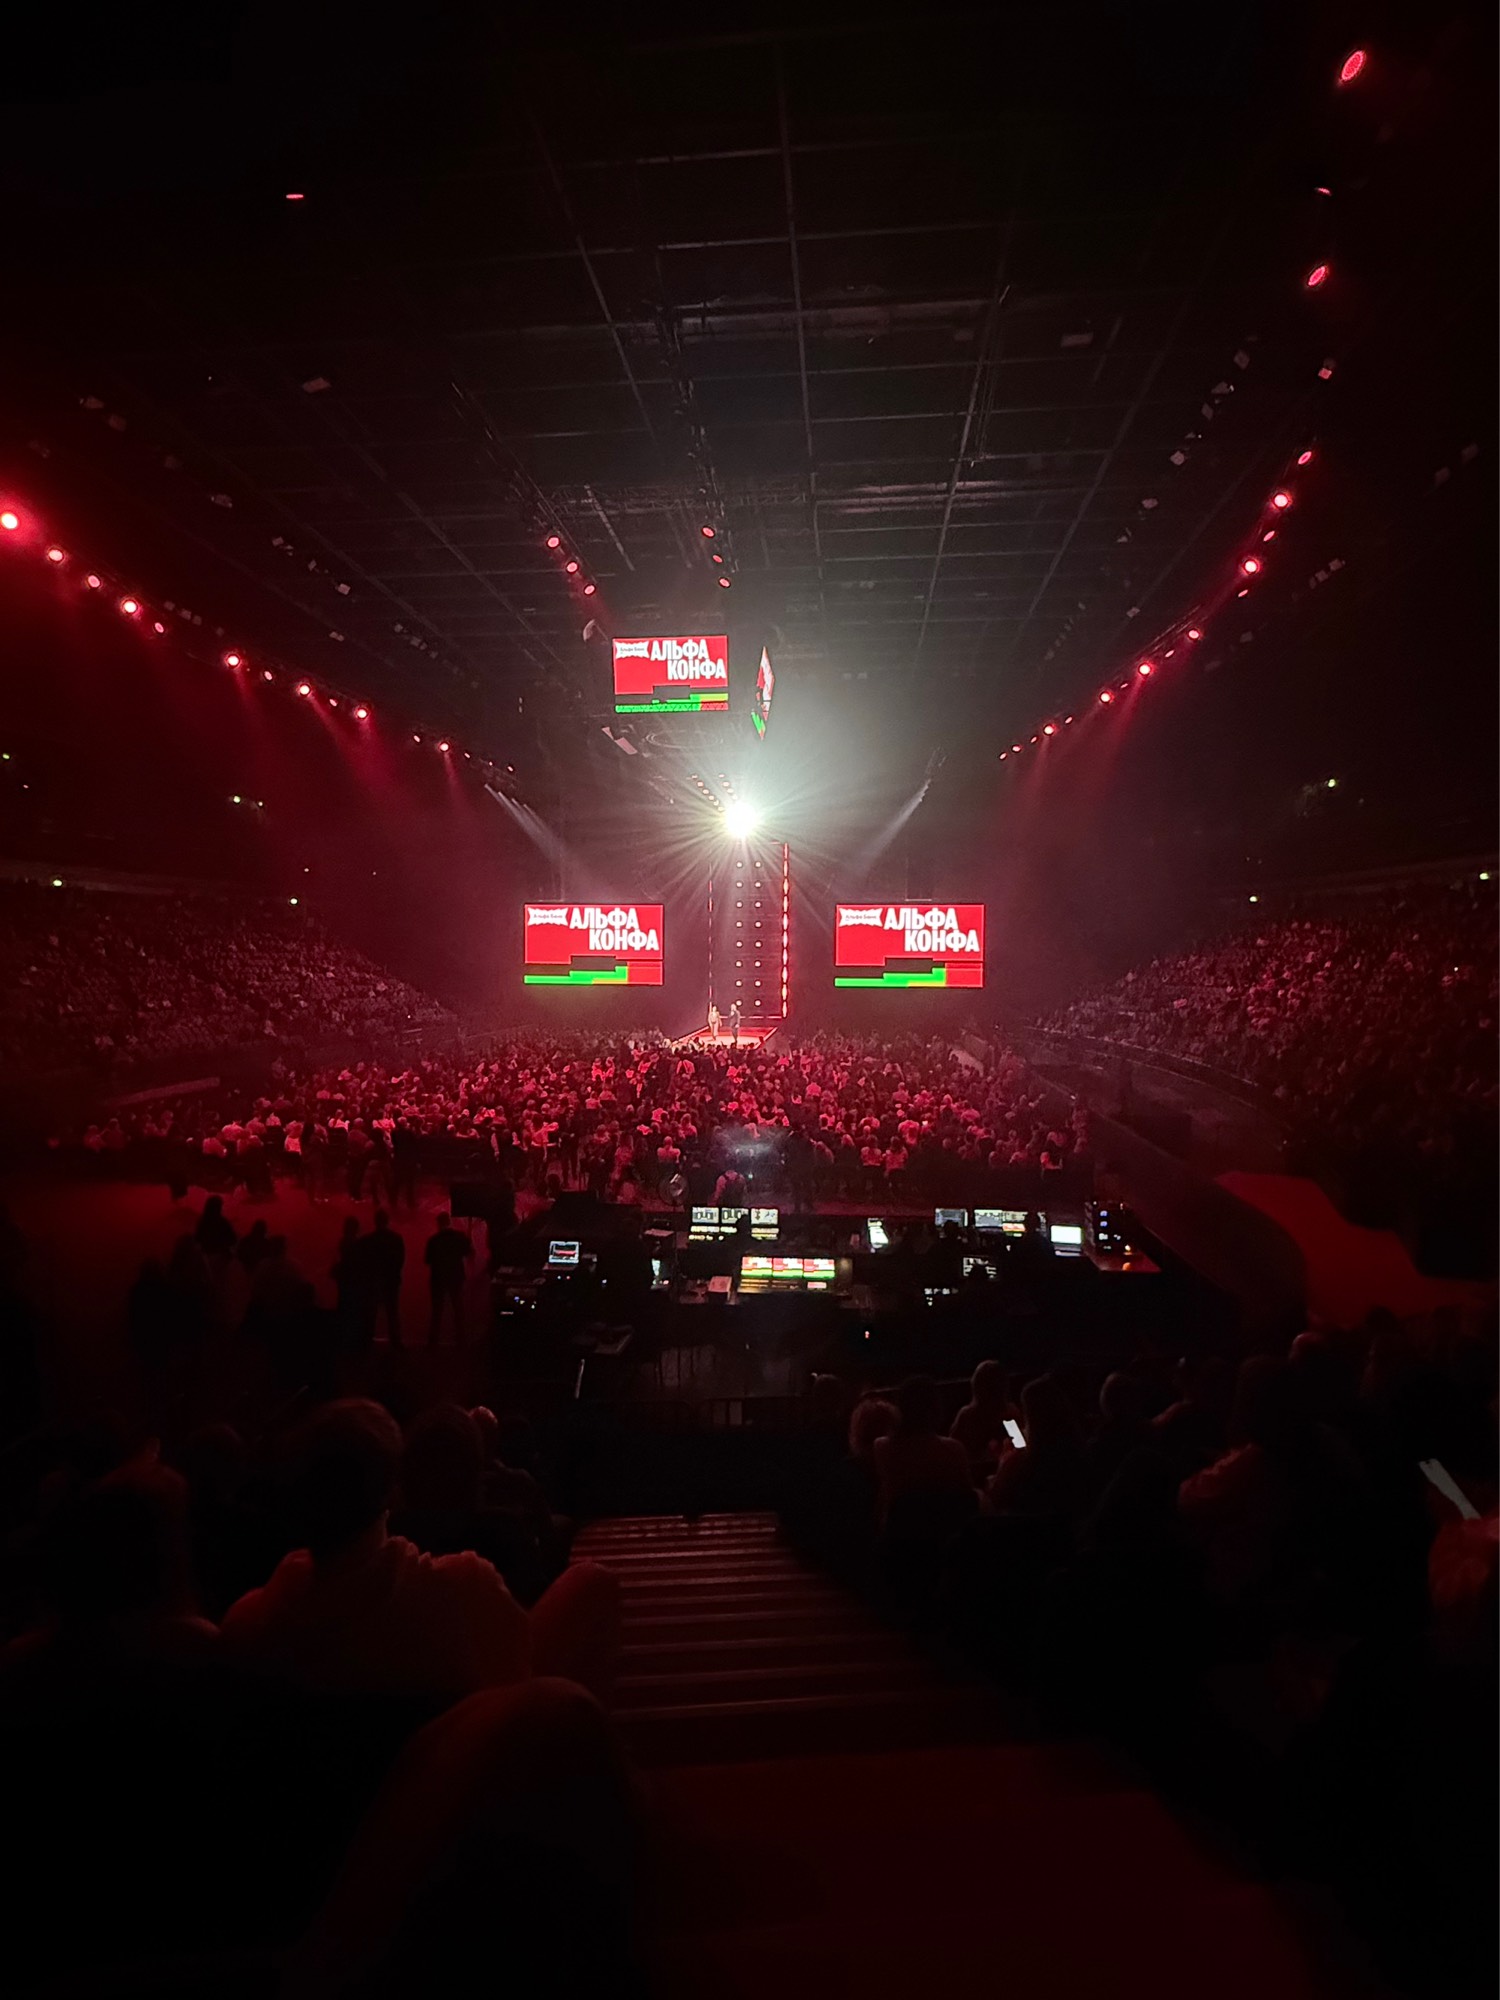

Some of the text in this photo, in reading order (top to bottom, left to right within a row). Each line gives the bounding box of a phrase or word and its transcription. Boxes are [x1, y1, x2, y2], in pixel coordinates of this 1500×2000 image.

[650, 639, 709, 661] АЛЬФА
[667, 659, 726, 680] КОНФА
[570, 907, 639, 929] АЛЬФА
[884, 907, 959, 930] АЛЬФА
[589, 928, 659, 951] КОНФА
[904, 929, 980, 952] КОНФА
